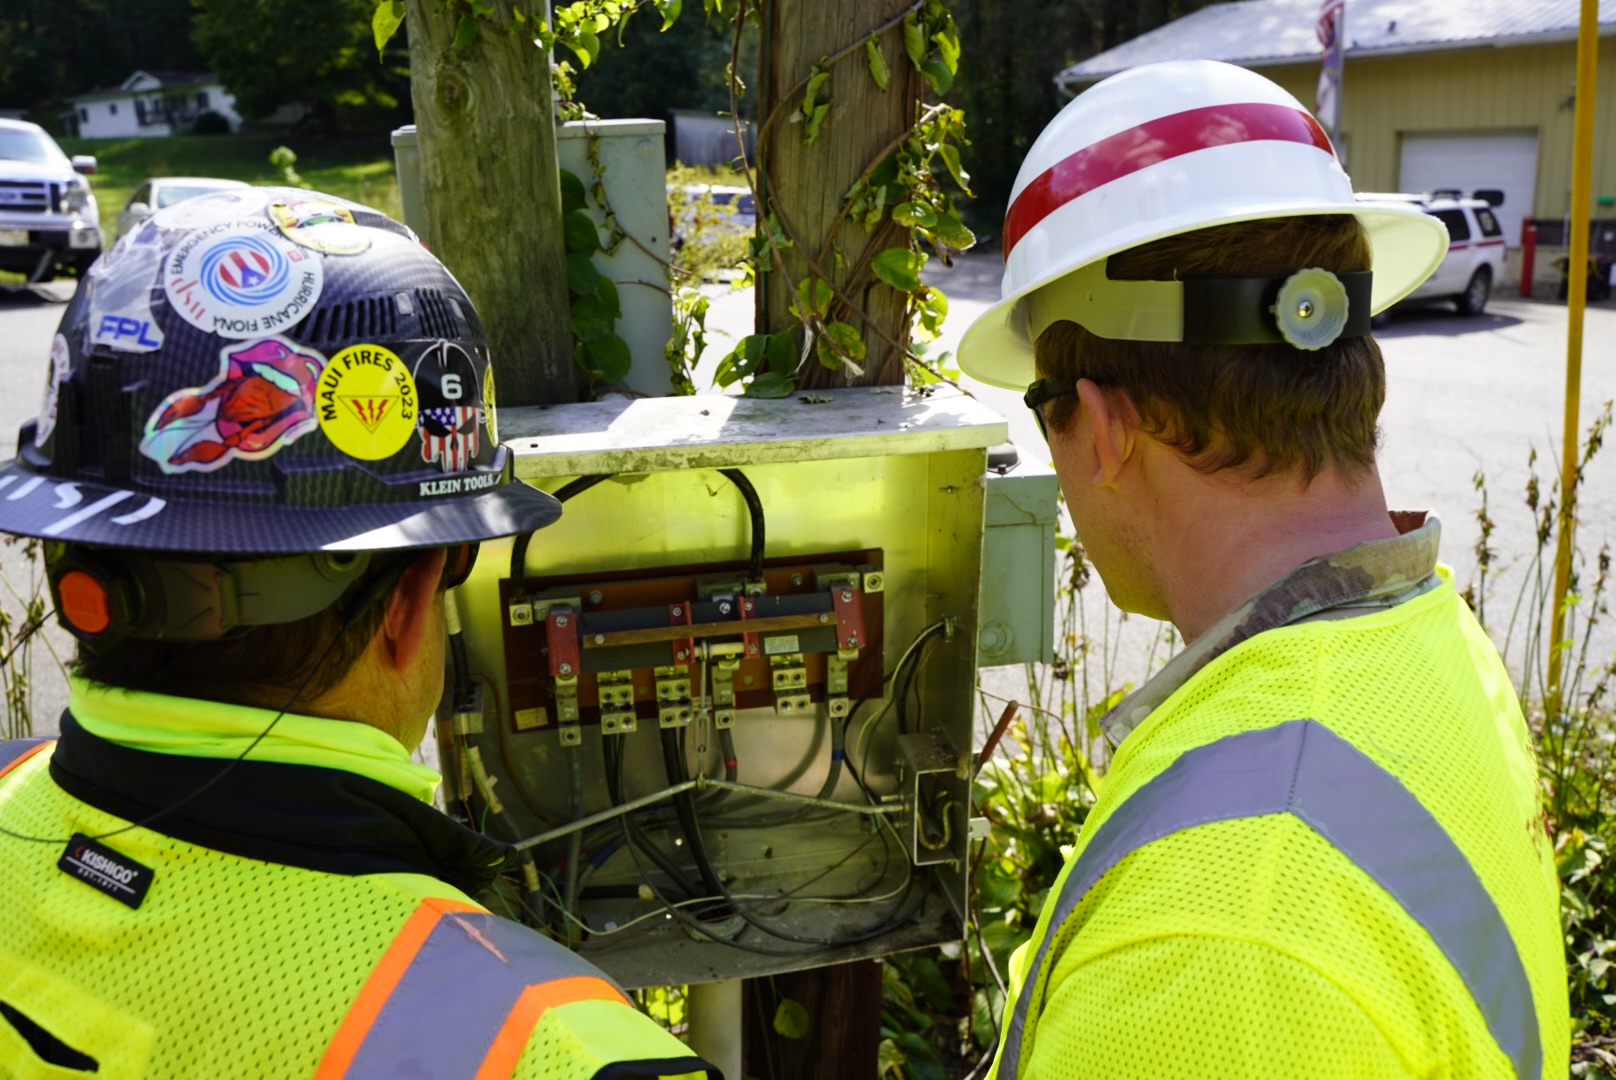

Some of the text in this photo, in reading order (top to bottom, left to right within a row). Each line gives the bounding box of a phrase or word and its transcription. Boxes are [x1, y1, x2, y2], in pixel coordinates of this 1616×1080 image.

[171, 221, 232, 275] EMERGENCY
[262, 271, 316, 330] HURRICANE
[97, 315, 160, 348] FPL
[321, 350, 413, 421] MAUI FIRES 2023
[441, 373, 463, 400] 6
[419, 479, 461, 496] KLEIN
[80, 849, 133, 884] KISHIGO
